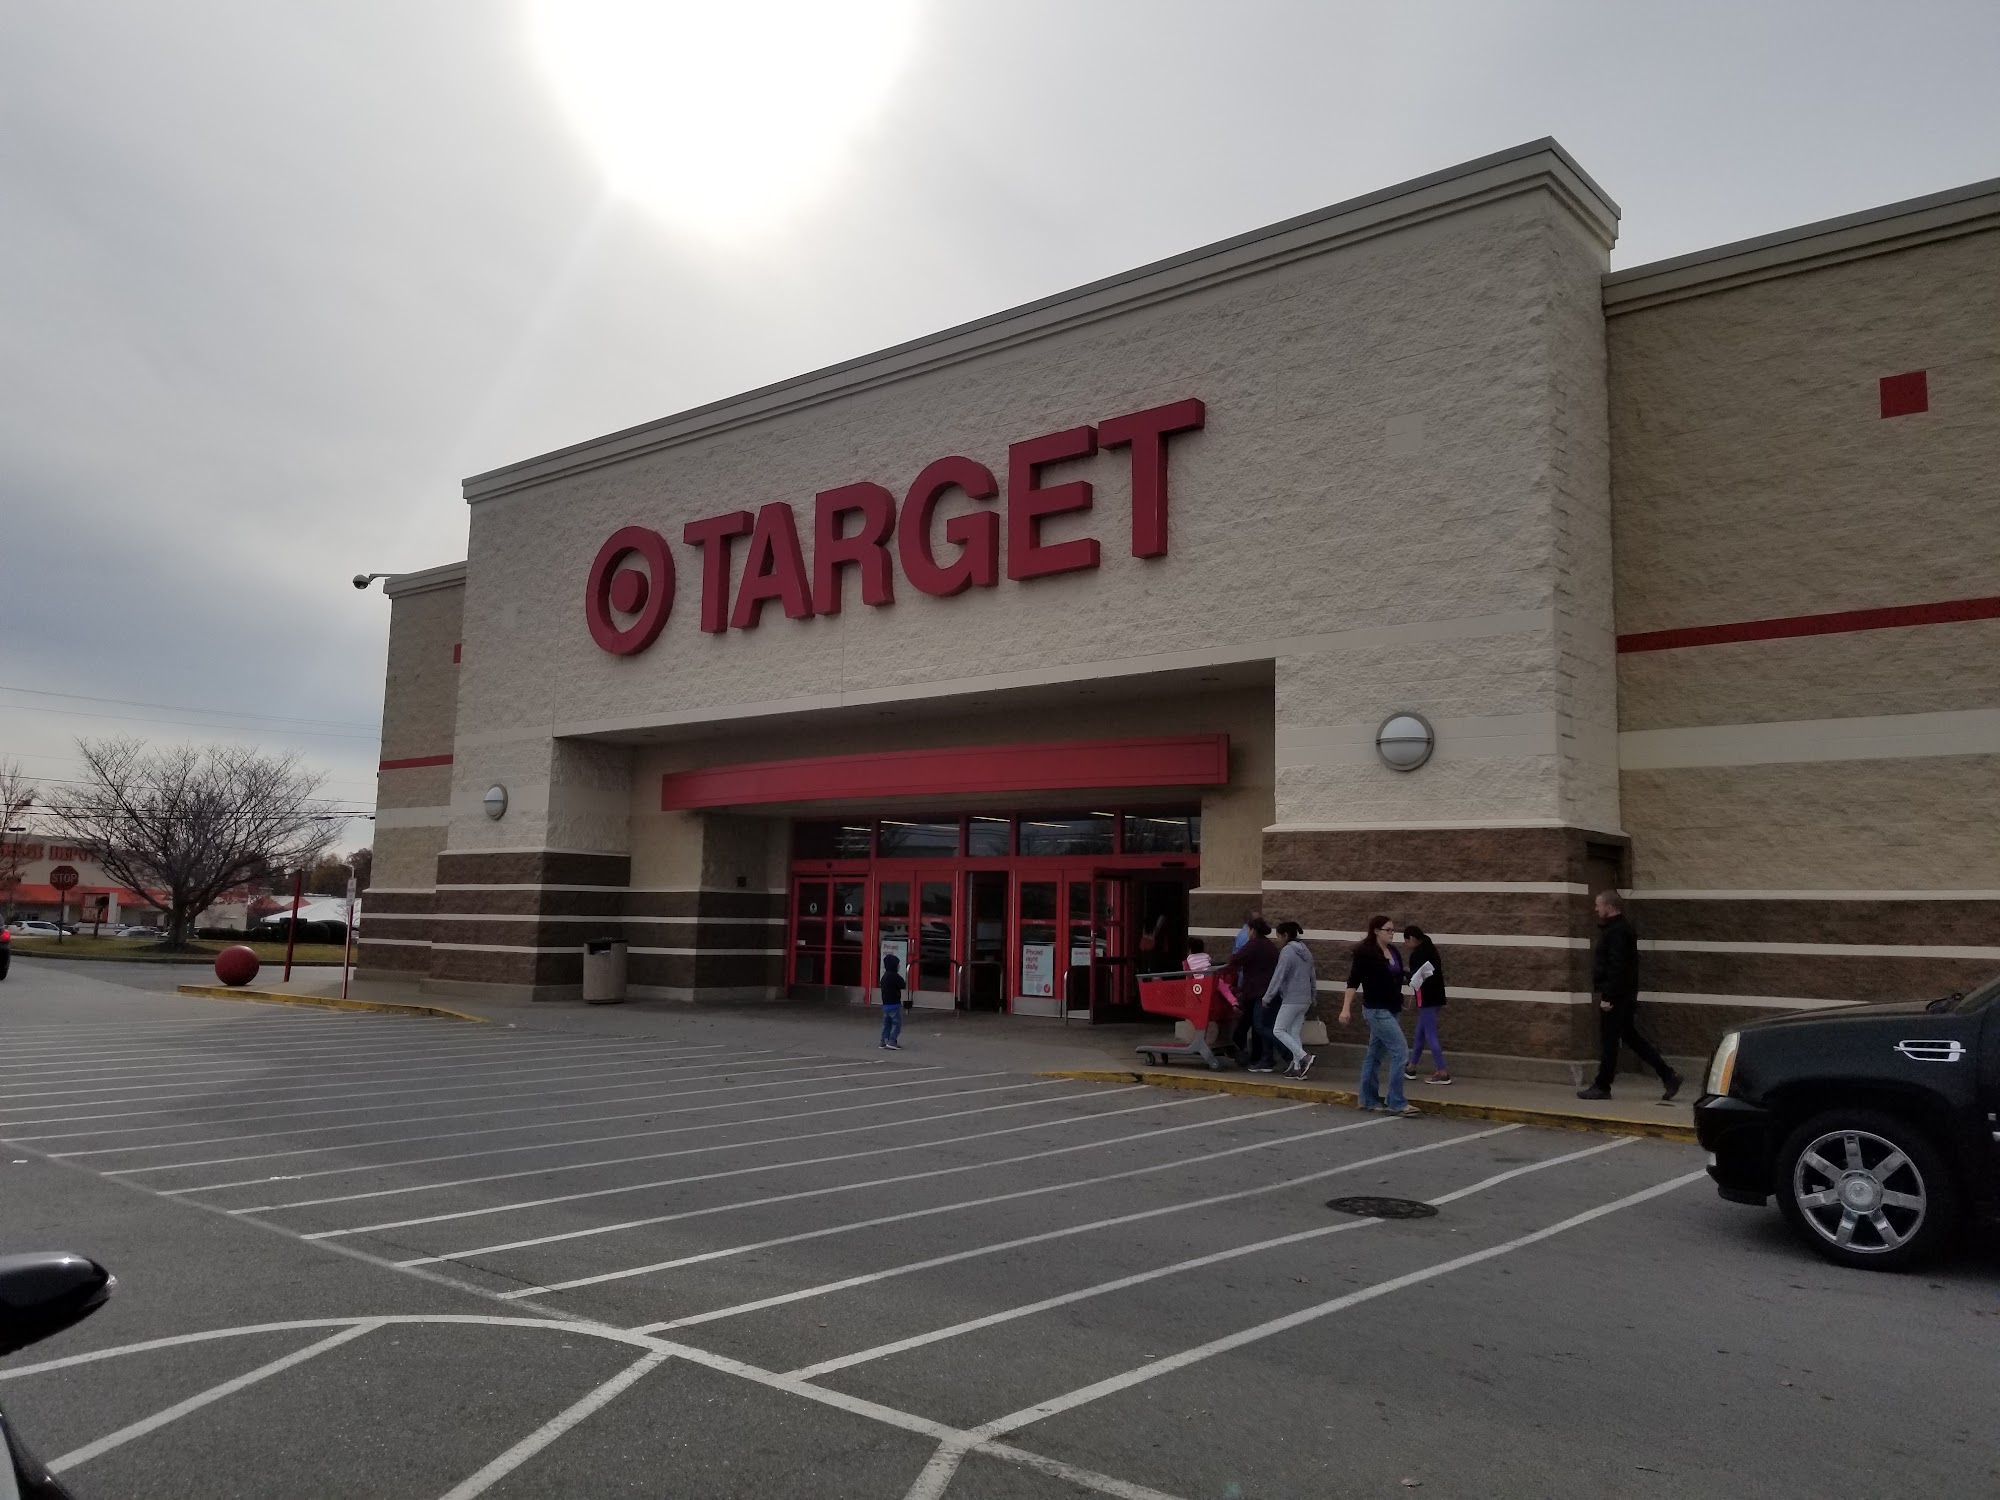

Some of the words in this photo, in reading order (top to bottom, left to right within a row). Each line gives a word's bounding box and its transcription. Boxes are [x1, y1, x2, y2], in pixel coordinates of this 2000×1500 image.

[683, 398, 1205, 633] TARGET
[52, 873, 78, 883] STOP
[1025, 948, 1044, 956] Priced
[1025, 956, 1039, 964] right
[1025, 963, 1039, 971] daily
